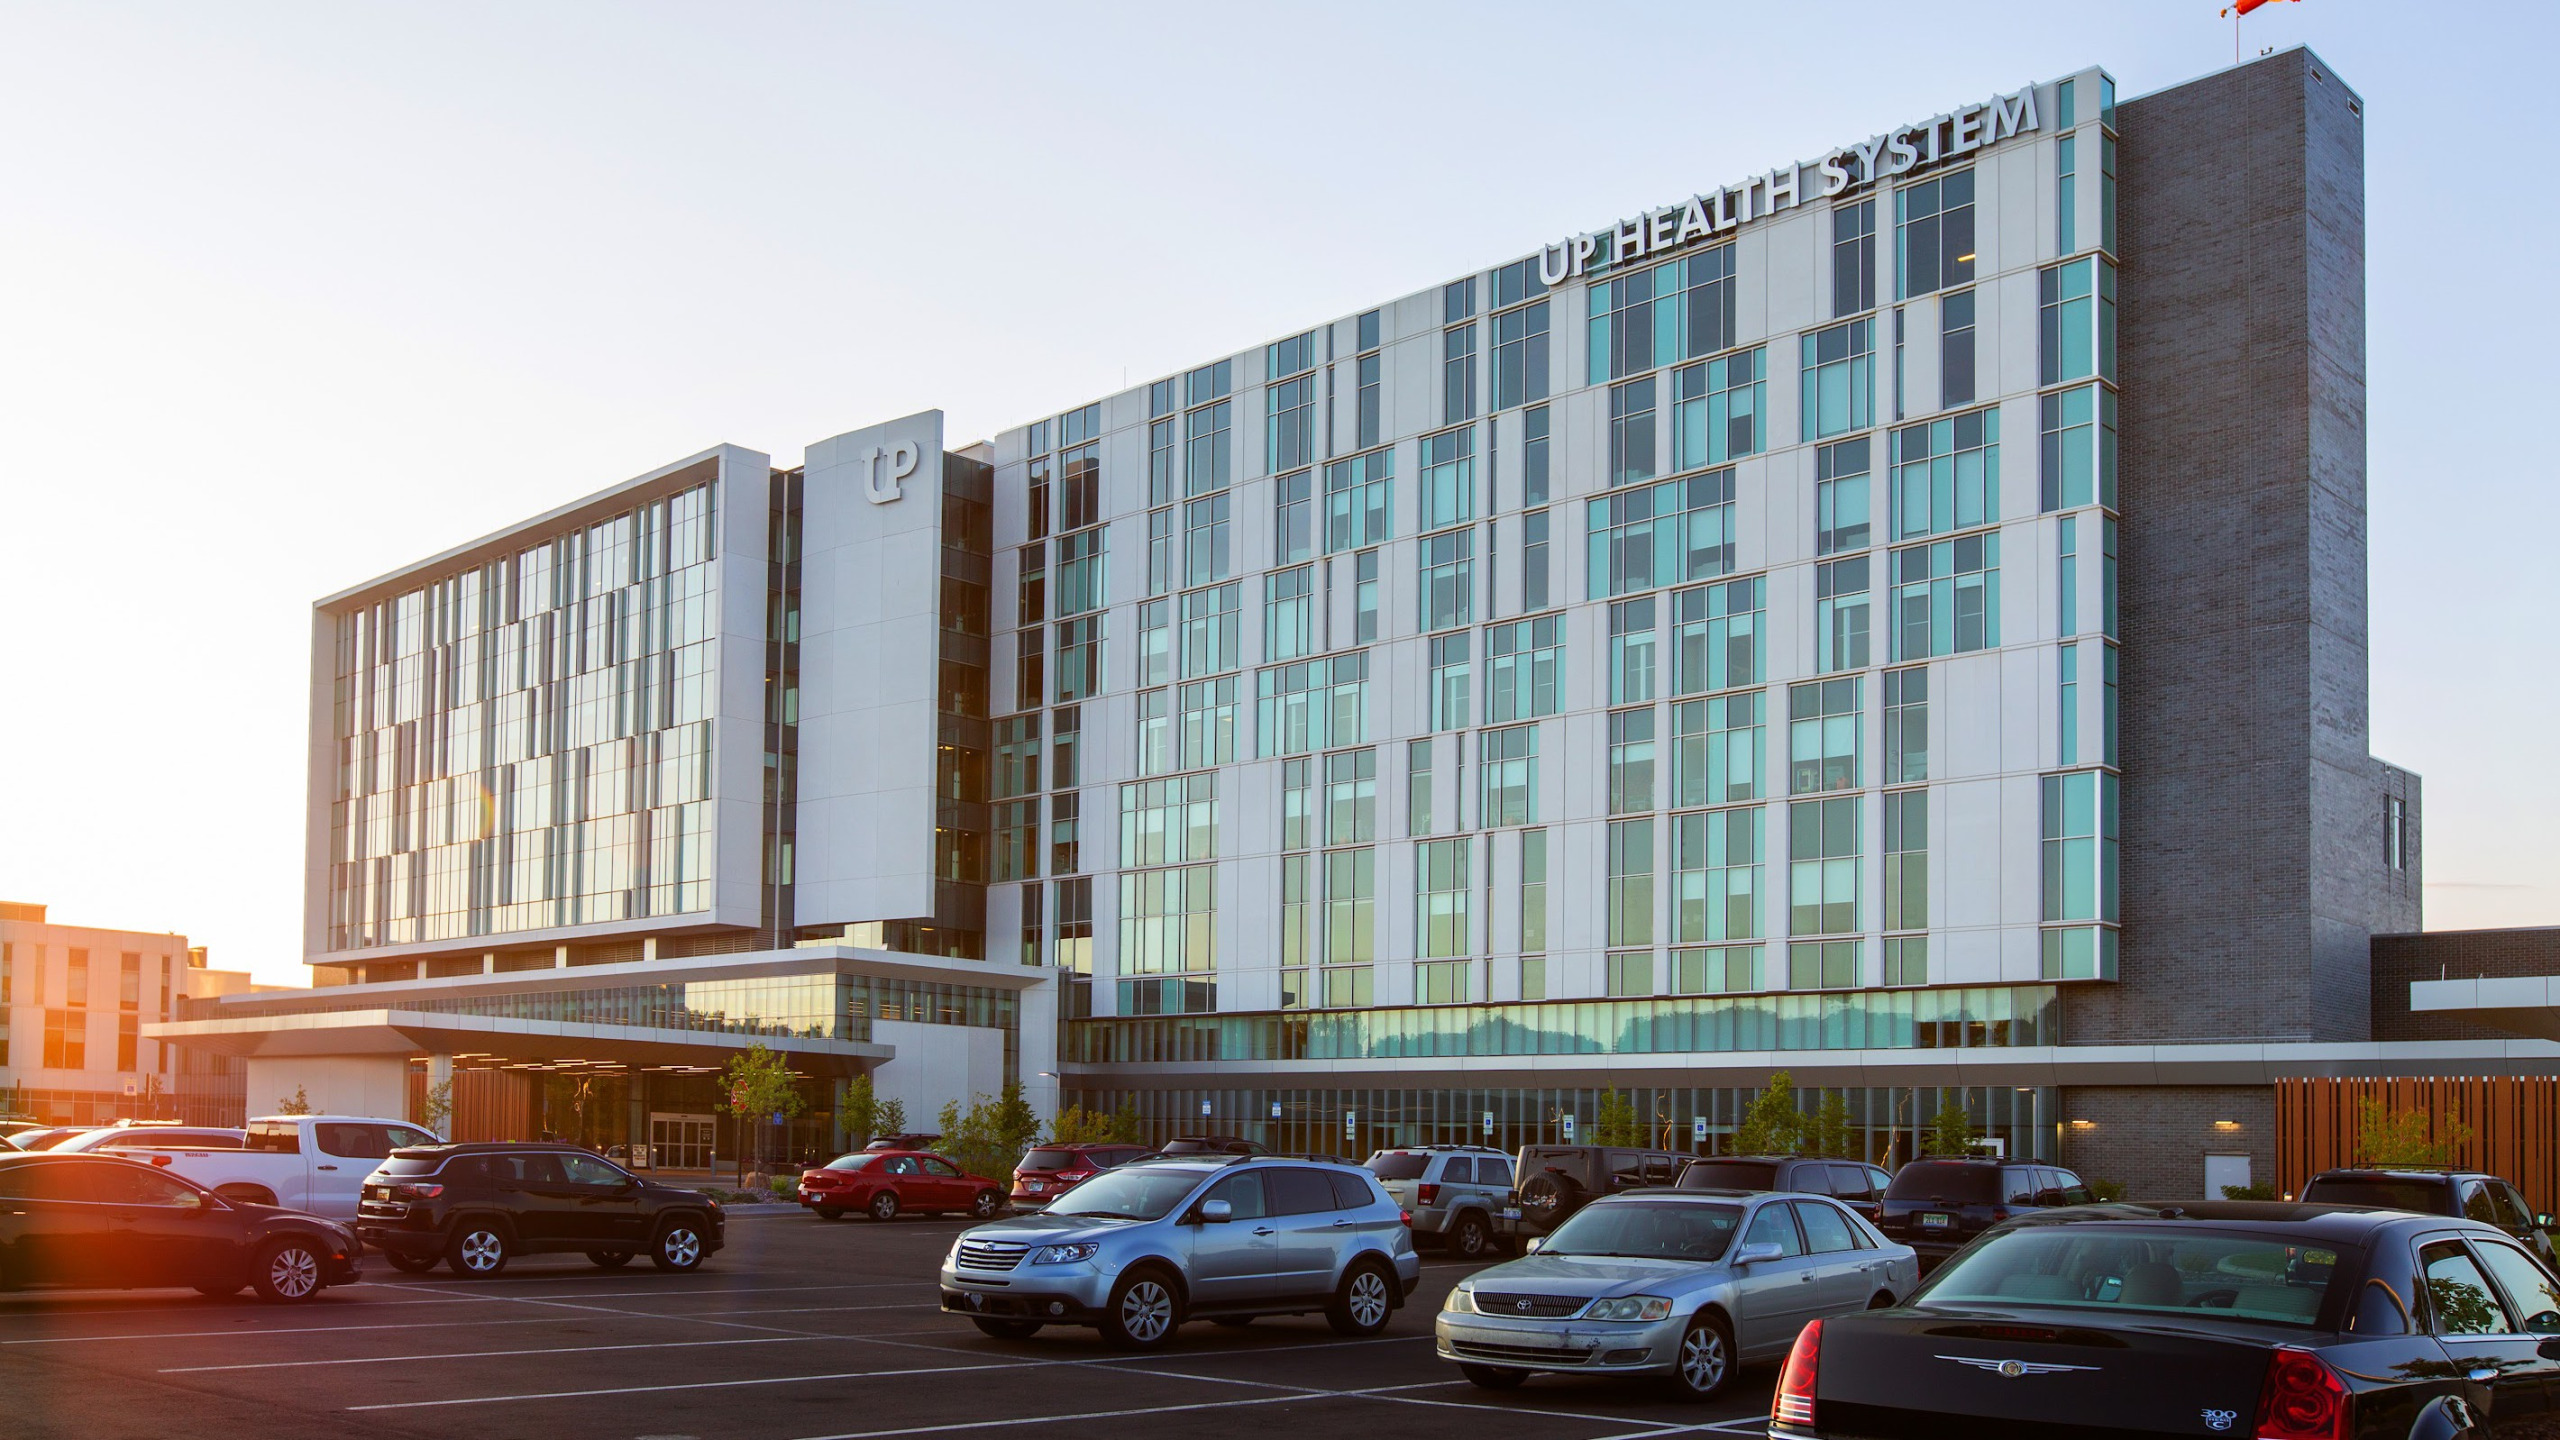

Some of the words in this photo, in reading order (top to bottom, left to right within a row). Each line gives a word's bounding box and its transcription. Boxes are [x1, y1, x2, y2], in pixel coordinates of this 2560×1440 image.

[1539, 235, 1597, 286] UP
[1613, 163, 1801, 264] HEALTH
[1819, 85, 2040, 197] SYSTEM
[861, 440, 919, 505] UP
[2200, 1408, 2238, 1419] 300
